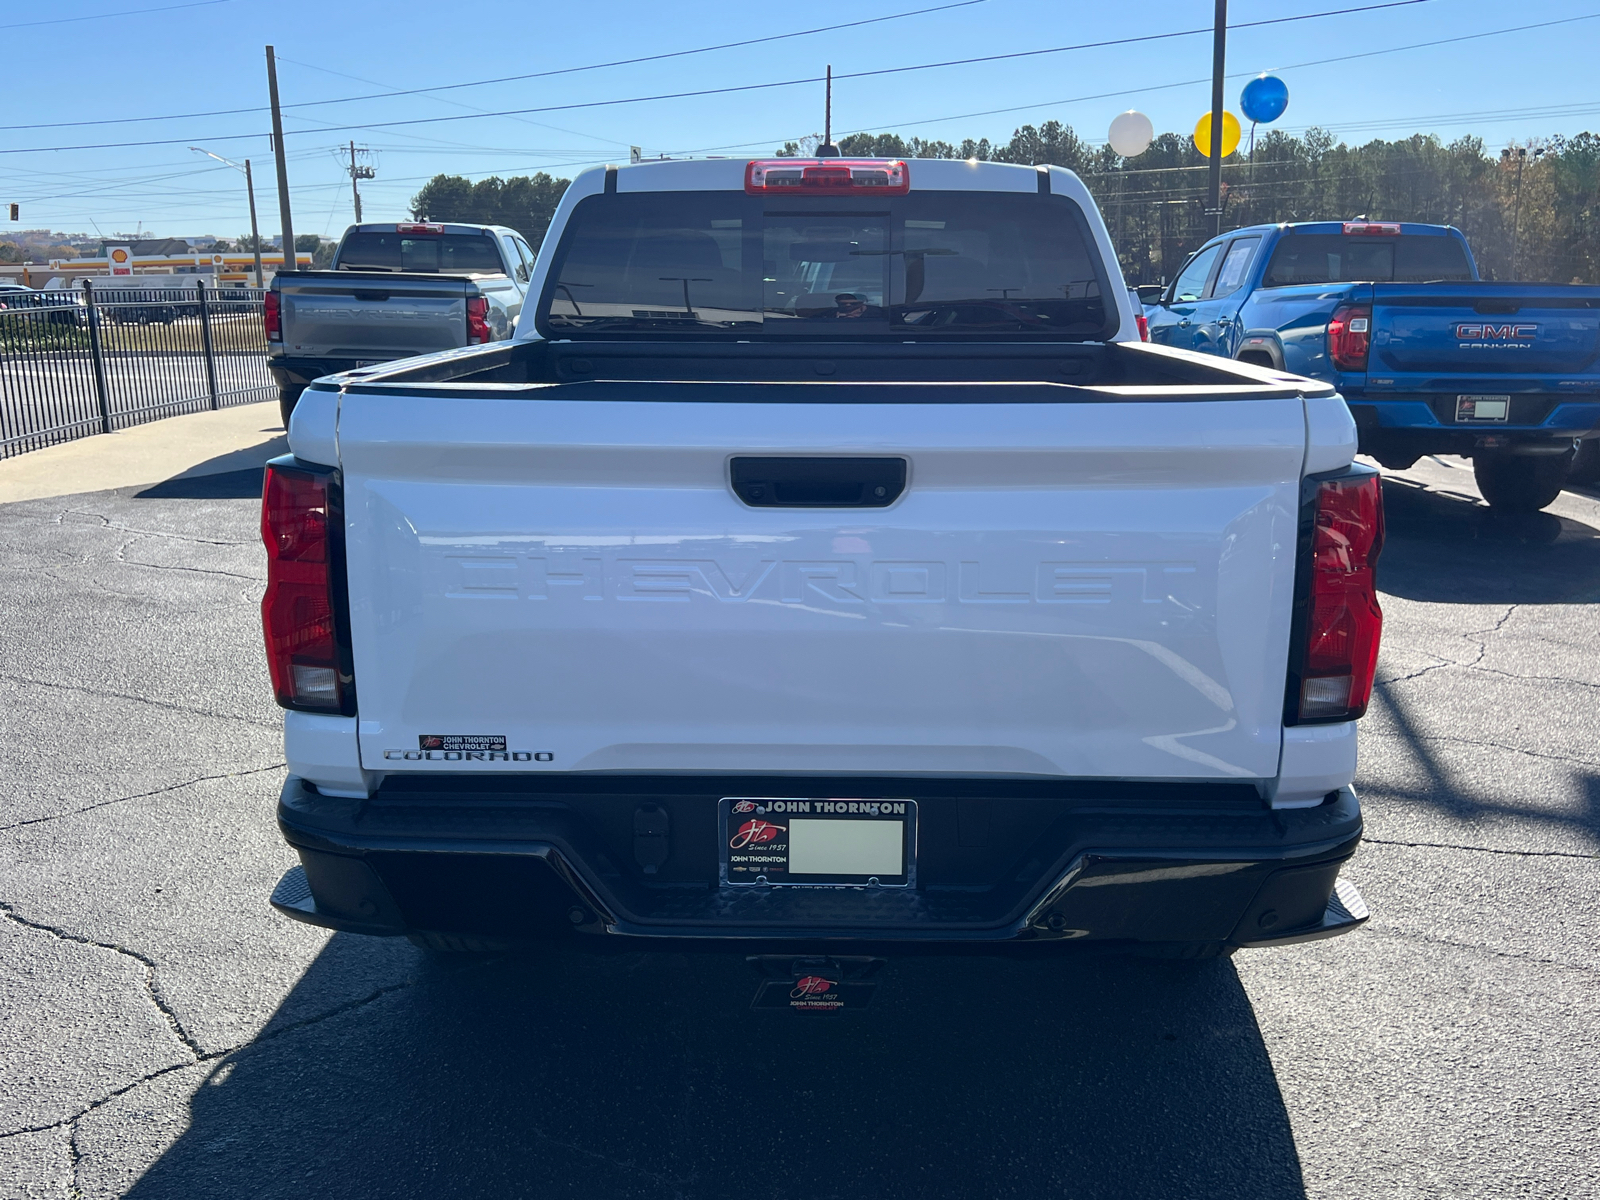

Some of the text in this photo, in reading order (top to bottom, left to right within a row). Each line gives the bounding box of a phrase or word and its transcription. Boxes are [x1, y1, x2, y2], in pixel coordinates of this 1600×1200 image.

[1456, 324, 1537, 339] GMC
[443, 556, 1197, 603] CHEVROLET
[443, 736, 505, 744] JOHN THORNTON
[383, 749, 554, 762] COLORADO
[765, 801, 905, 814] JOHN THORNTON
[748, 843, 768, 851] Since
